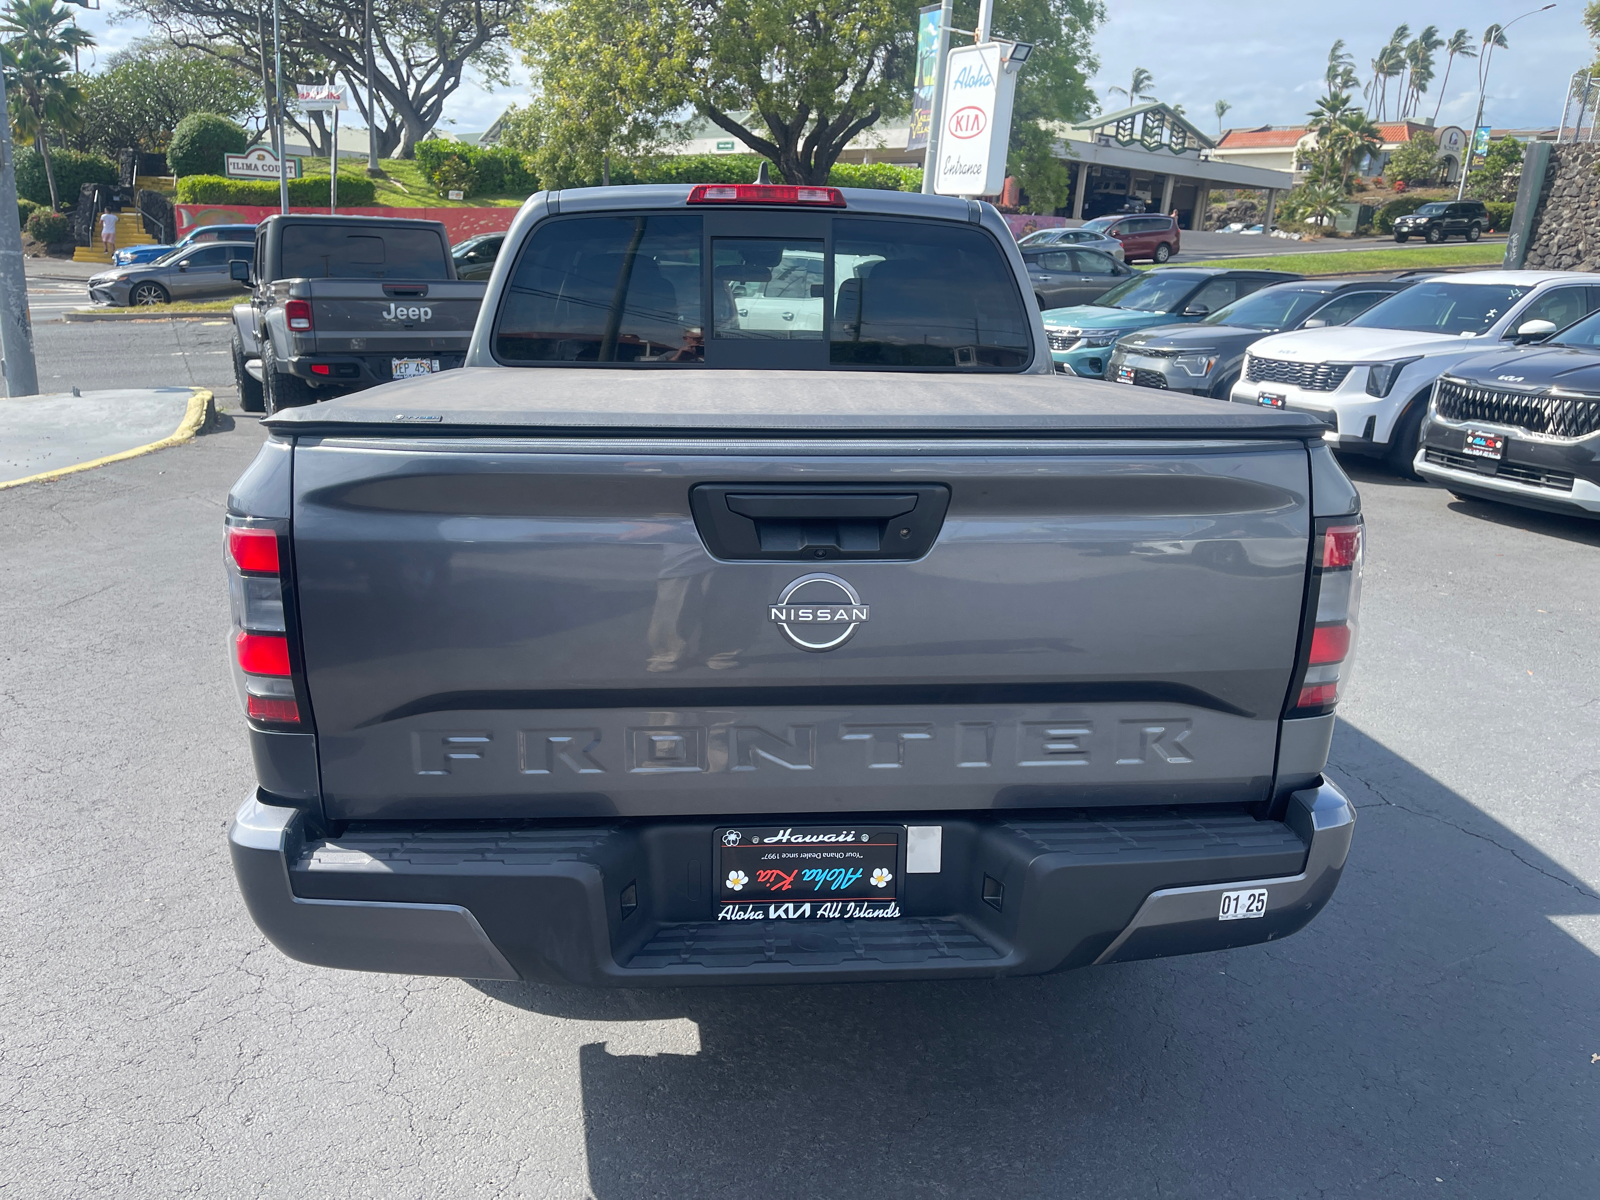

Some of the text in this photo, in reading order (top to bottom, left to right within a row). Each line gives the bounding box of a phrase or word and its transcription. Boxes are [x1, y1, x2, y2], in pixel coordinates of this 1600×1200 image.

[953, 64, 991, 90] Aloha
[955, 114, 980, 132] KIA
[261, 164, 293, 174] COUT
[943, 155, 982, 175] Entrance
[382, 303, 432, 322] Jeep
[771, 608, 867, 621] NISSAN
[411, 717, 1194, 775] FRONTIER
[763, 828, 856, 844] Hawaii
[756, 867, 863, 891] Aloha Kia
[718, 902, 901, 921] Aloha KIA All Islands
[1221, 892, 1266, 915] 01 25
